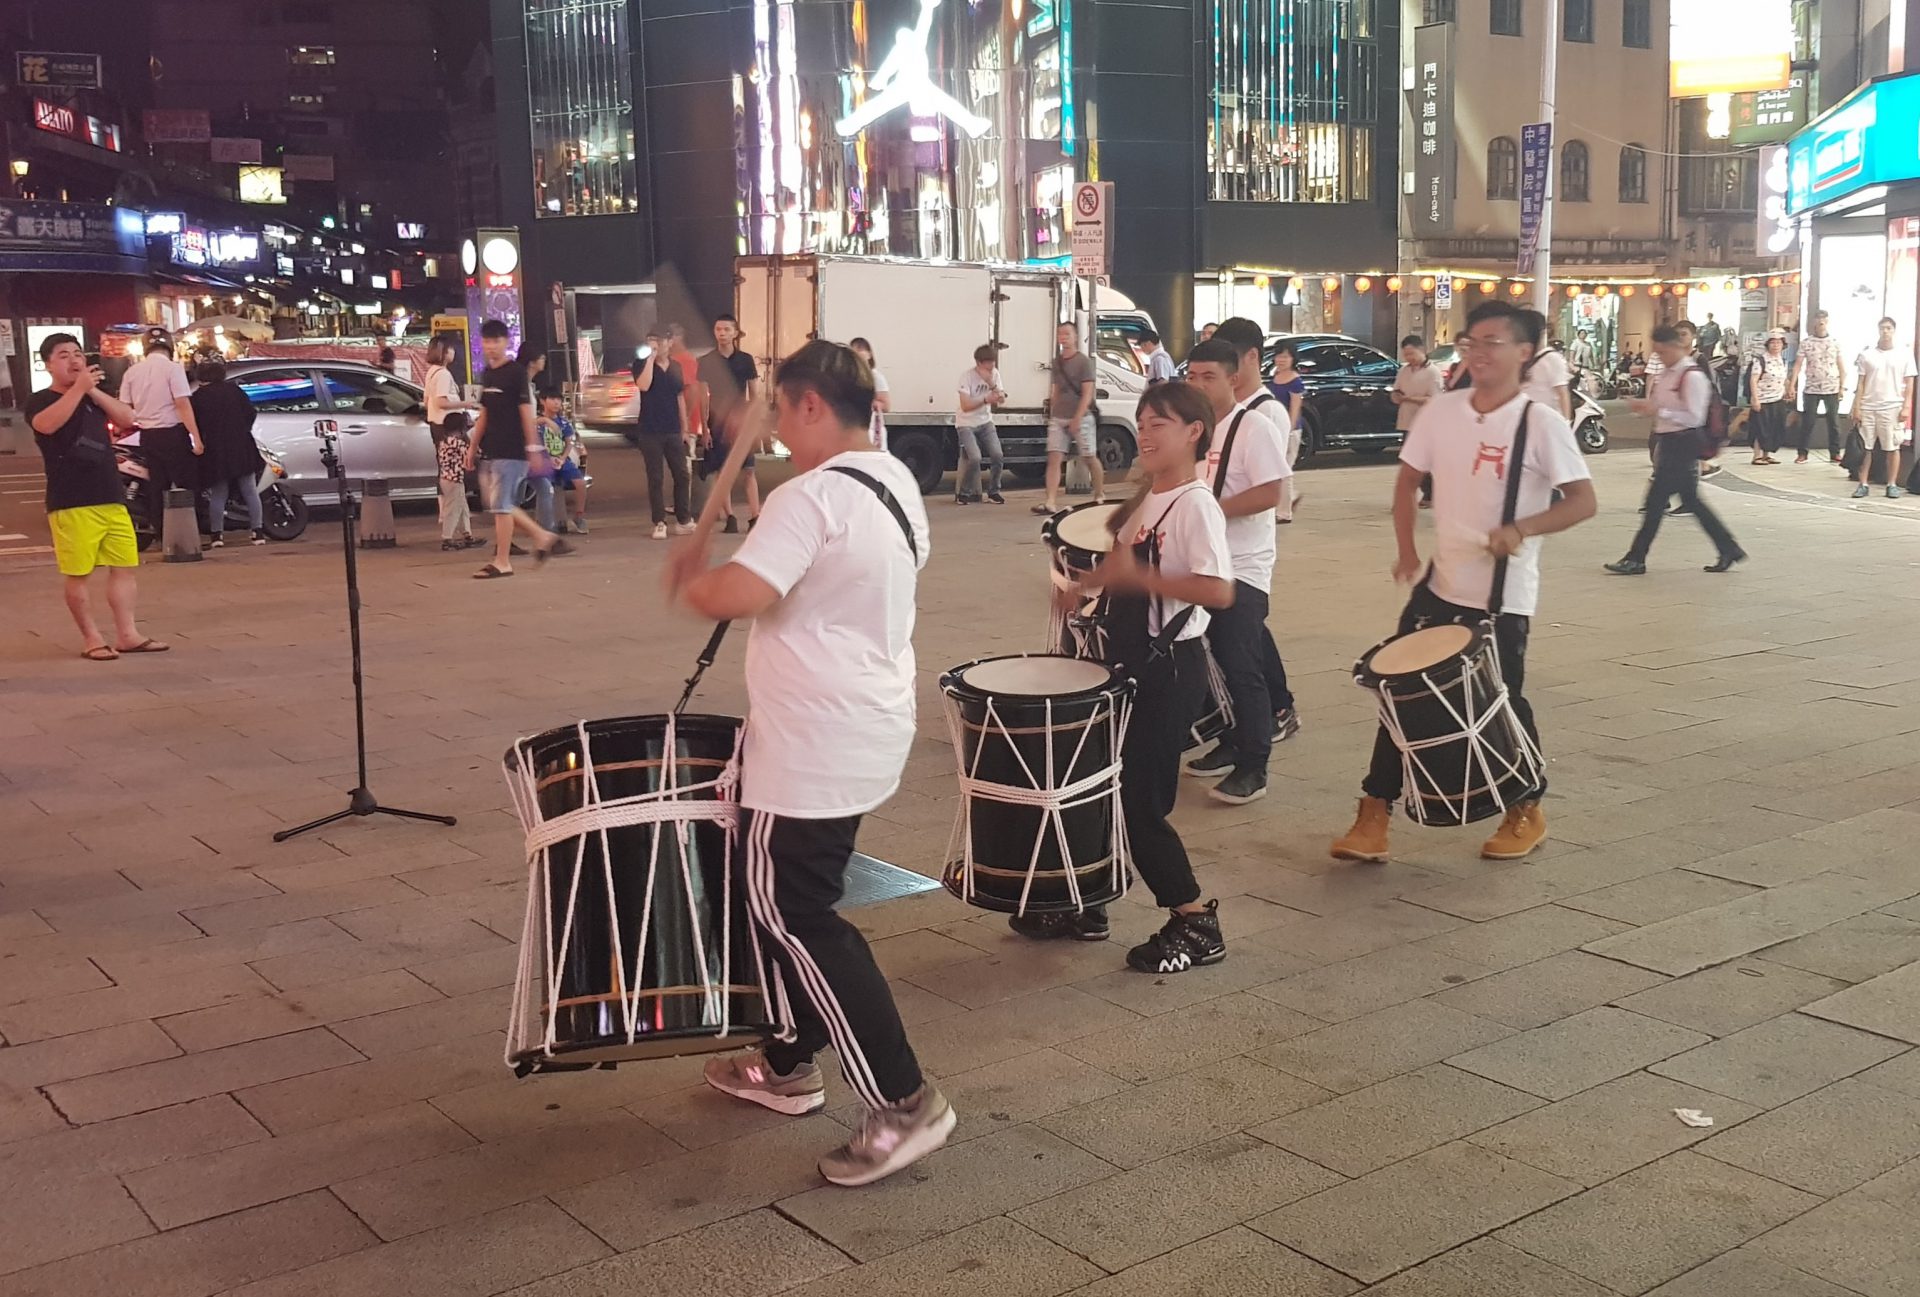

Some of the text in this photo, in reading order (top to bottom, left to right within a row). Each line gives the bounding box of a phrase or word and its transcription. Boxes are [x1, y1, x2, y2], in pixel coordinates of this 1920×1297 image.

[1422, 62, 1437, 155] 門卡迪咖啡
